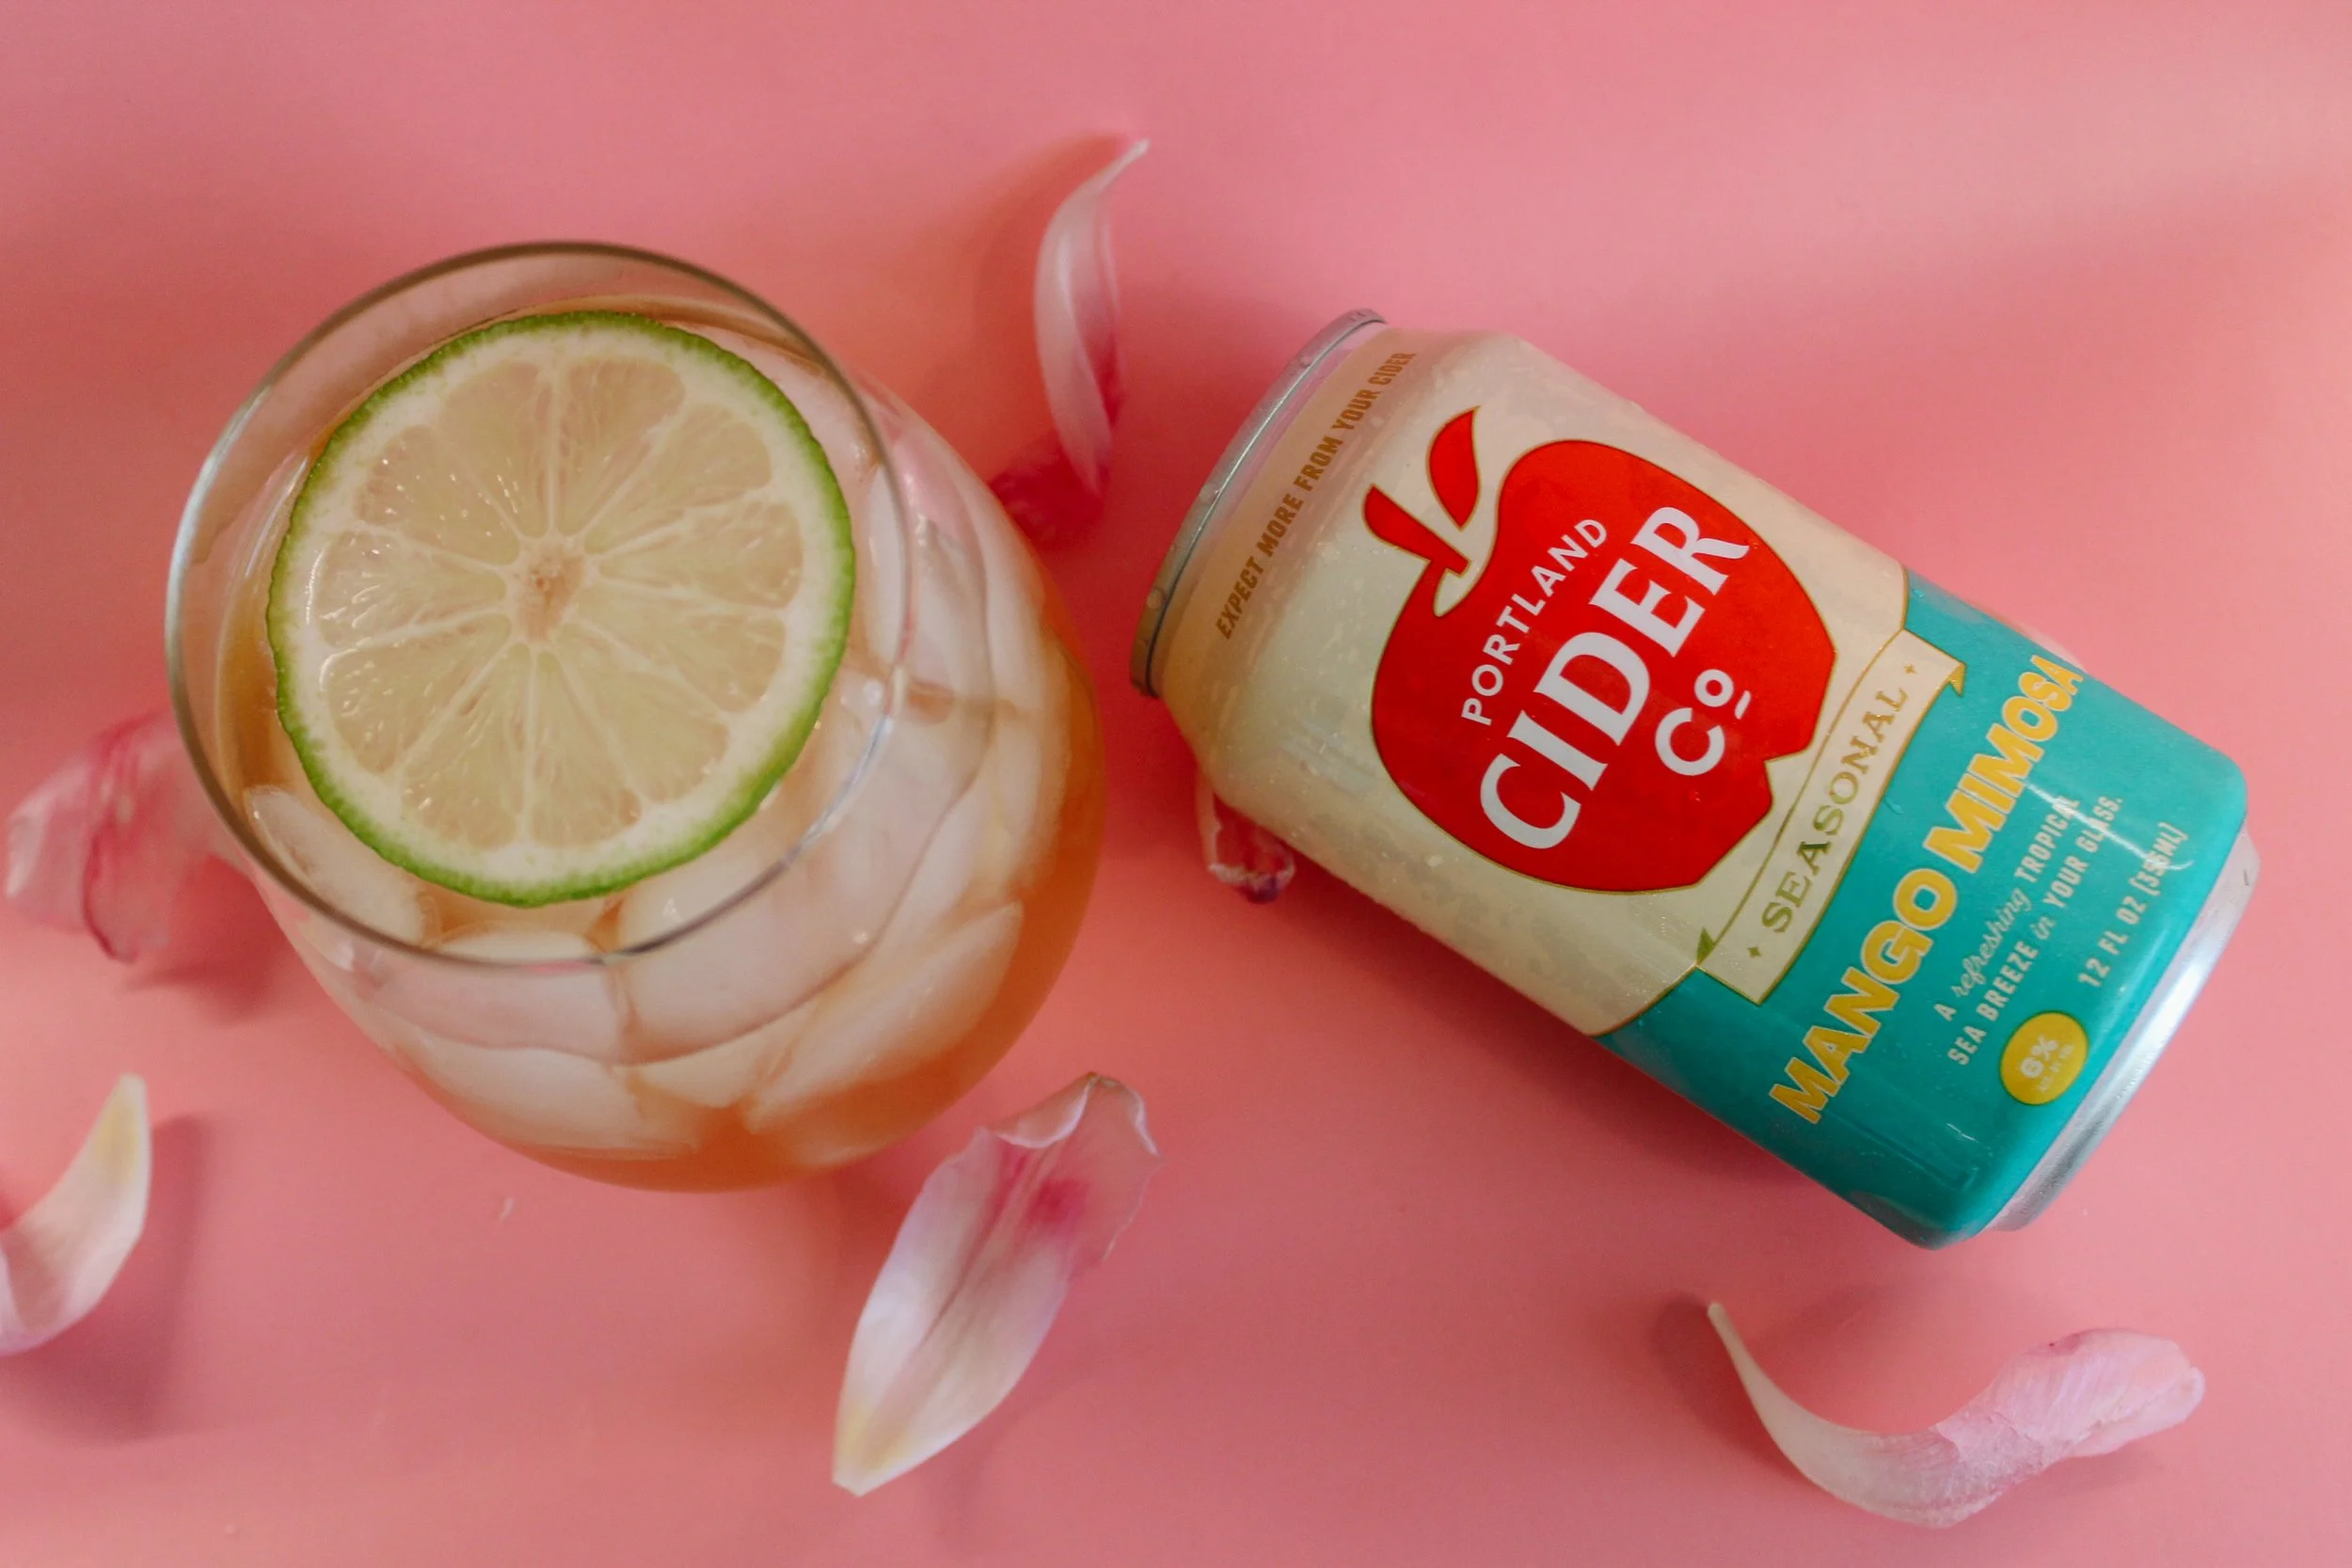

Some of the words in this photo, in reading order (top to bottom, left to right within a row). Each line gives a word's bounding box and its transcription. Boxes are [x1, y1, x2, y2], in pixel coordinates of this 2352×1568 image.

[1215, 557, 1264, 640] EXPECT
[1256, 492, 1305, 557] MORE
[1293, 436, 1343, 492] FROM
[1331, 388, 1381, 431] YOUR
[1368, 352, 1417, 386] CIDER
[1461, 518, 1608, 726] PORTLAND
[1480, 506, 1750, 848] CIDER
[1761, 685, 1909, 934] SEASONAL
[1769, 867, 1957, 1123] MANGO
[1924, 655, 2085, 873] MIMOSA
[1933, 1003, 1957, 1022] A
[1950, 888, 2033, 998] refreshing
[2013, 796, 2081, 883] TROPICAL
[2042, 854, 2090, 910] YOUR
[1976, 941, 2040, 1022] BREEZE
[2031, 915, 2058, 941] in
[2077, 958, 2110, 988] 12
[2098, 930, 2129, 956] FL
[2116, 895, 2148, 926] OZ
[1947, 1024, 1988, 1065] SEA
